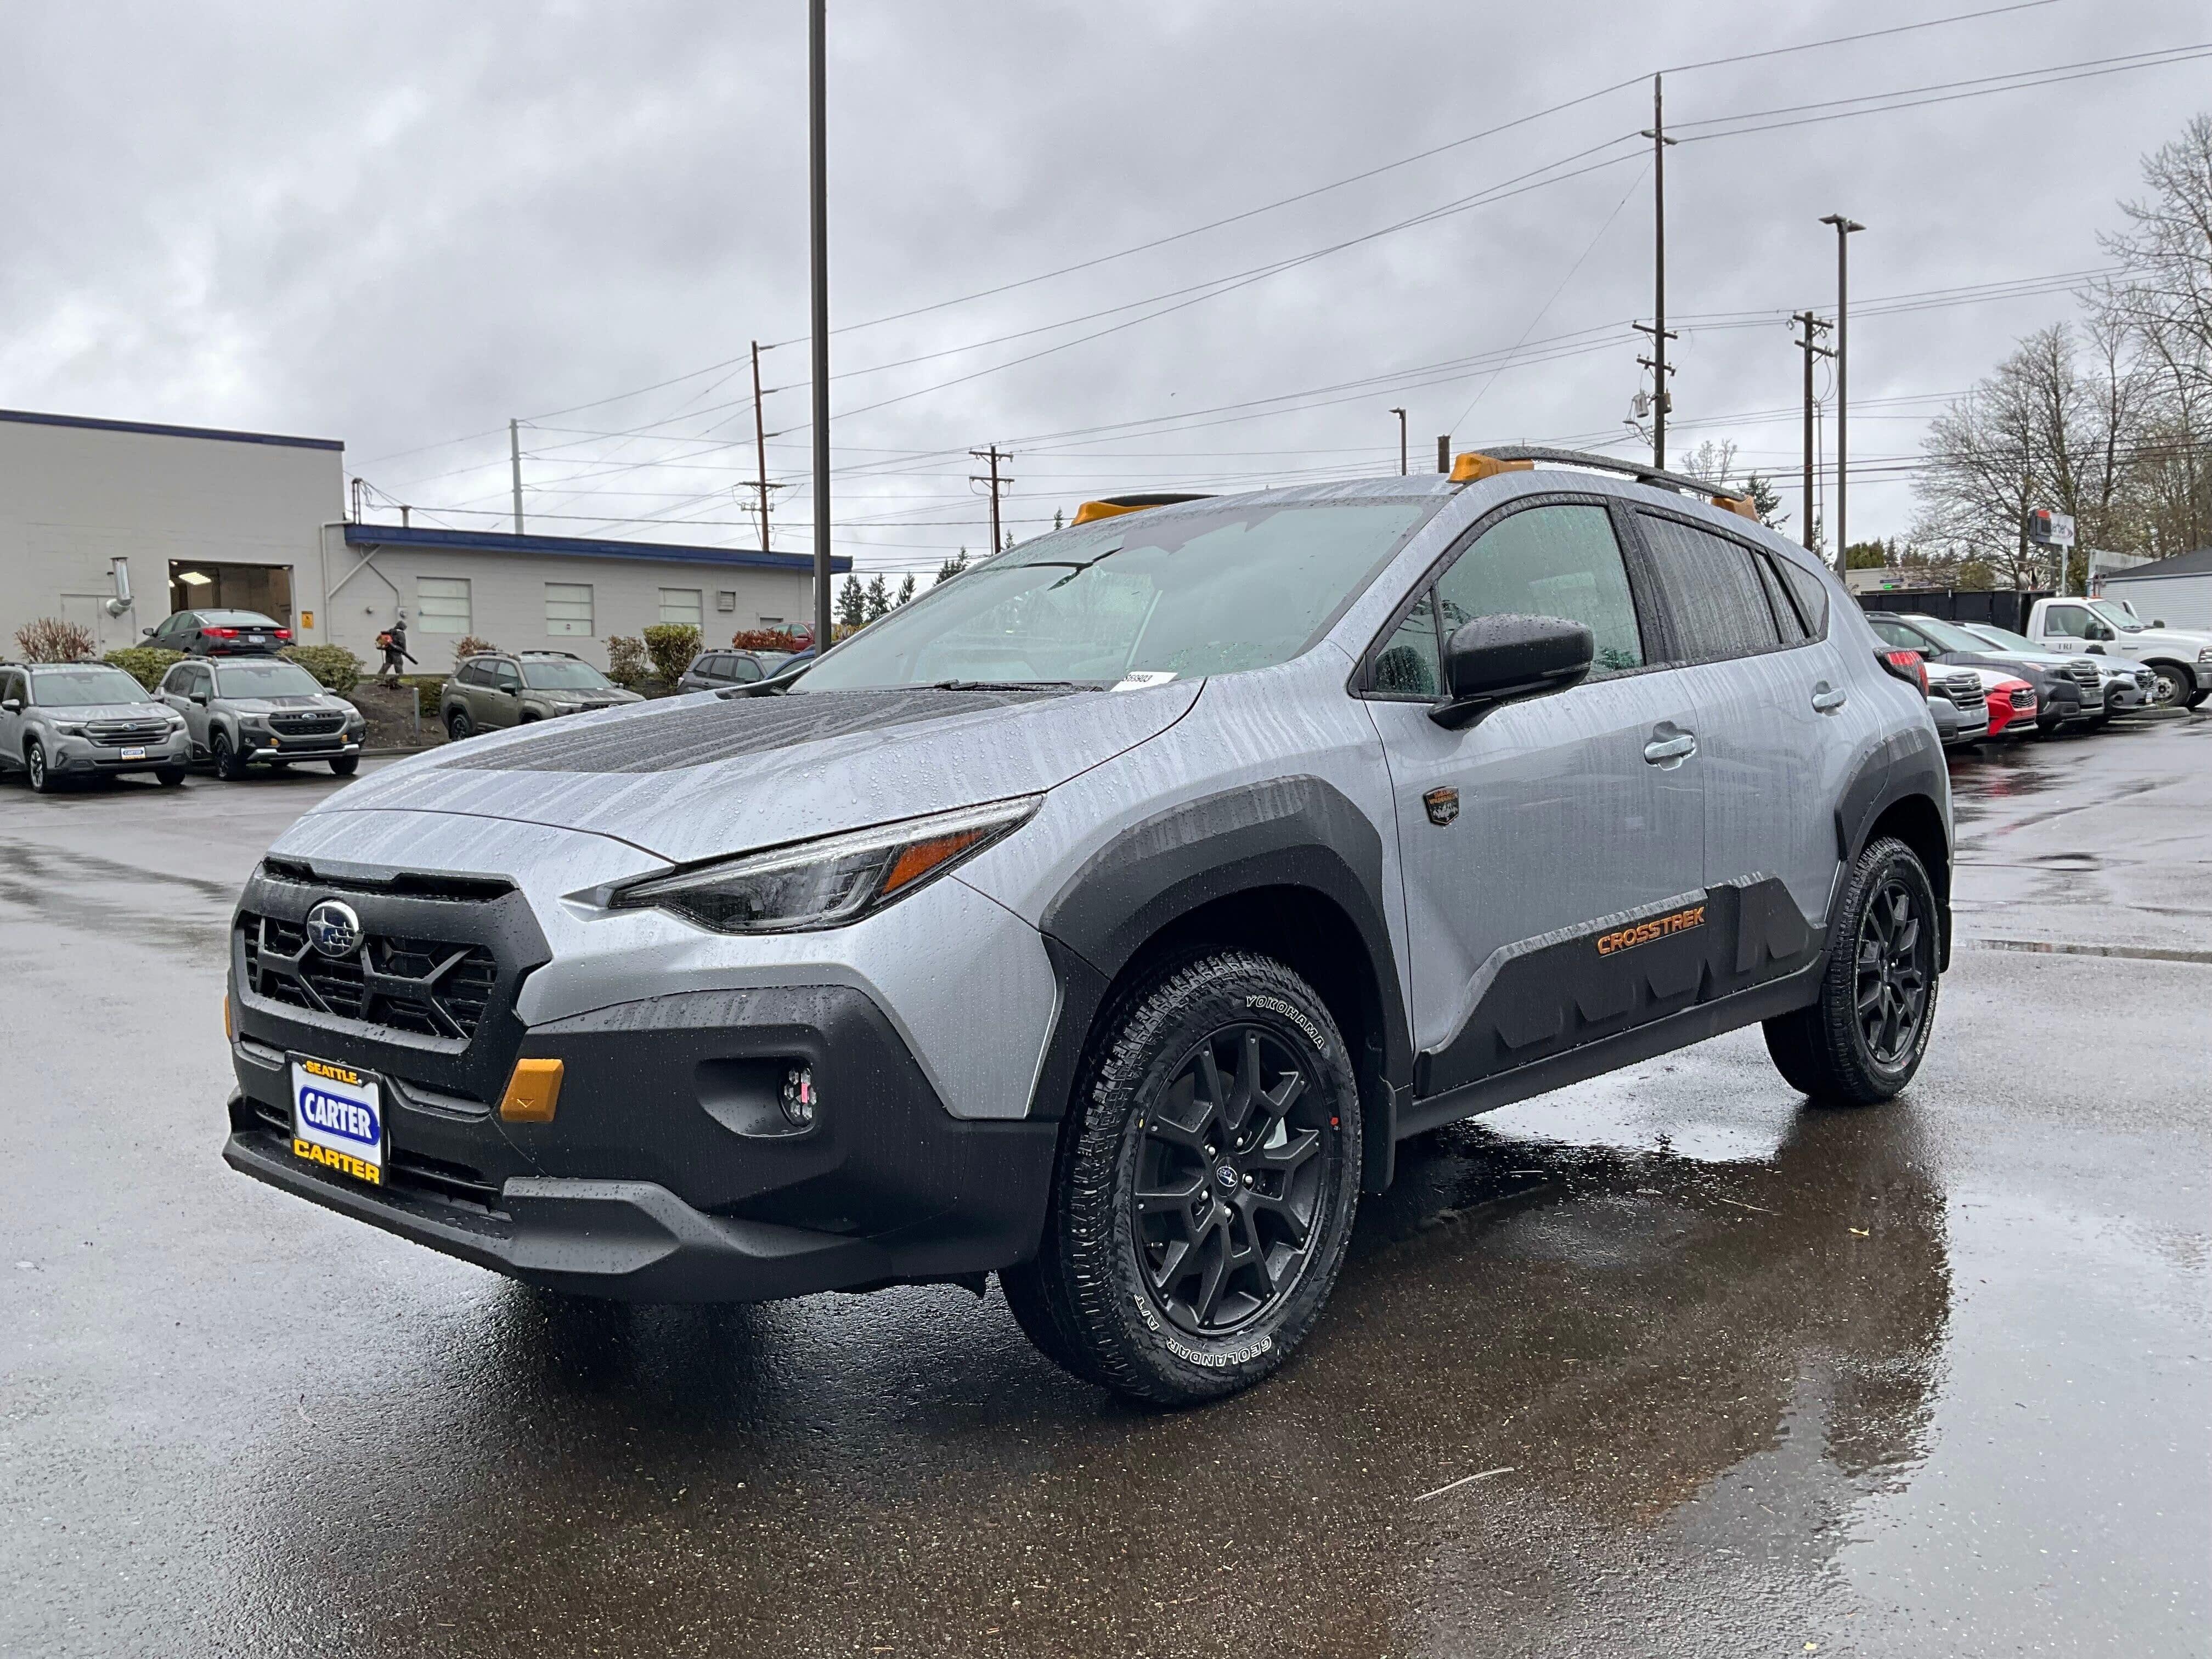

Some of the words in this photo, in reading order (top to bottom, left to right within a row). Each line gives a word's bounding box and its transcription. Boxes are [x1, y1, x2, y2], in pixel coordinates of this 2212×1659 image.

[1598, 906, 1705, 954] CROSSTREK
[1246, 995, 1325, 1050] YOKOHAMA
[306, 1060, 358, 1085] SEATTLE
[305, 1092, 373, 1139] CARTER
[293, 1138, 380, 1184] CARTER
[1133, 1294, 1160, 1331] A/T
[1166, 1336, 1272, 1367] GEOLANDAR
